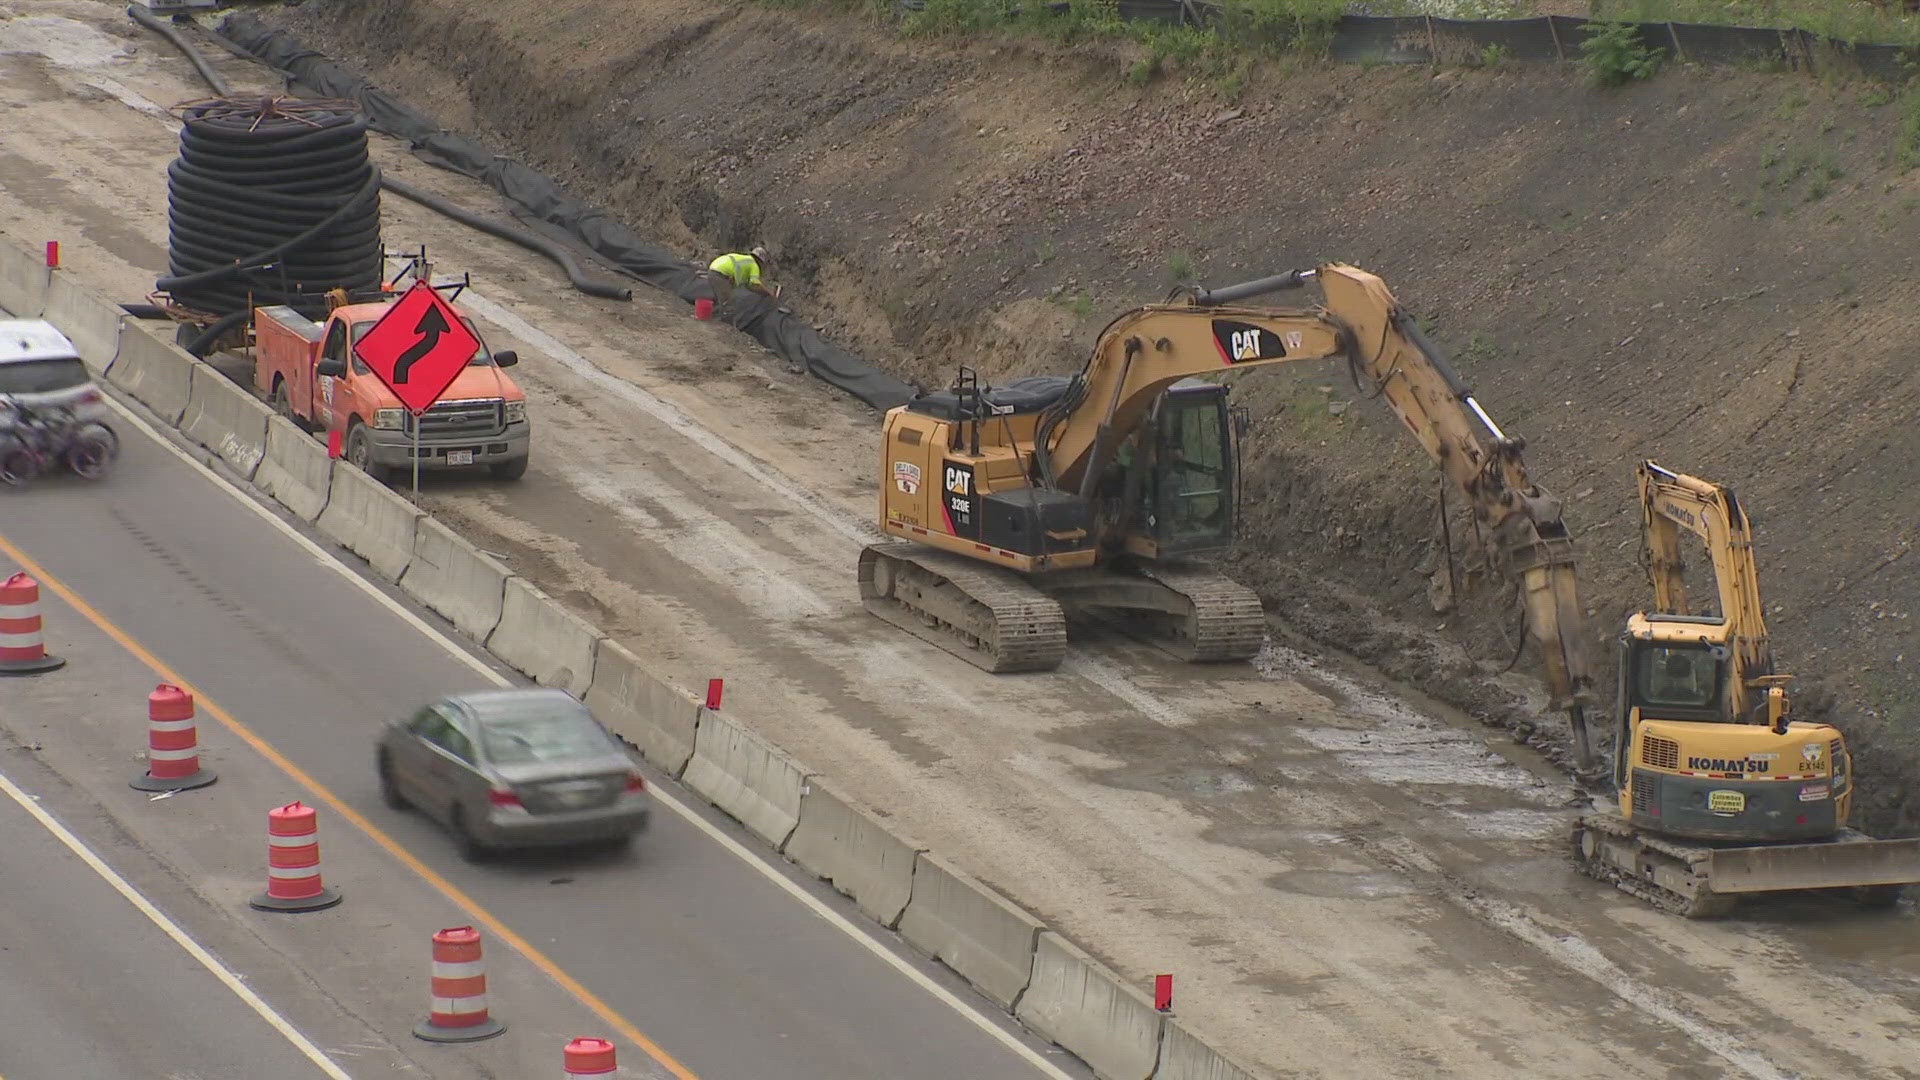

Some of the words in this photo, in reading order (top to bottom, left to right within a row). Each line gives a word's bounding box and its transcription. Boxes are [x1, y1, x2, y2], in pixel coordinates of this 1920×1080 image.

[1231, 329, 1261, 360] CAT
[946, 466, 971, 496] CAT
[951, 496, 970, 514] 320E
[1688, 756, 1769, 773] KOMATSU
[1799, 761, 1826, 771] EX145
